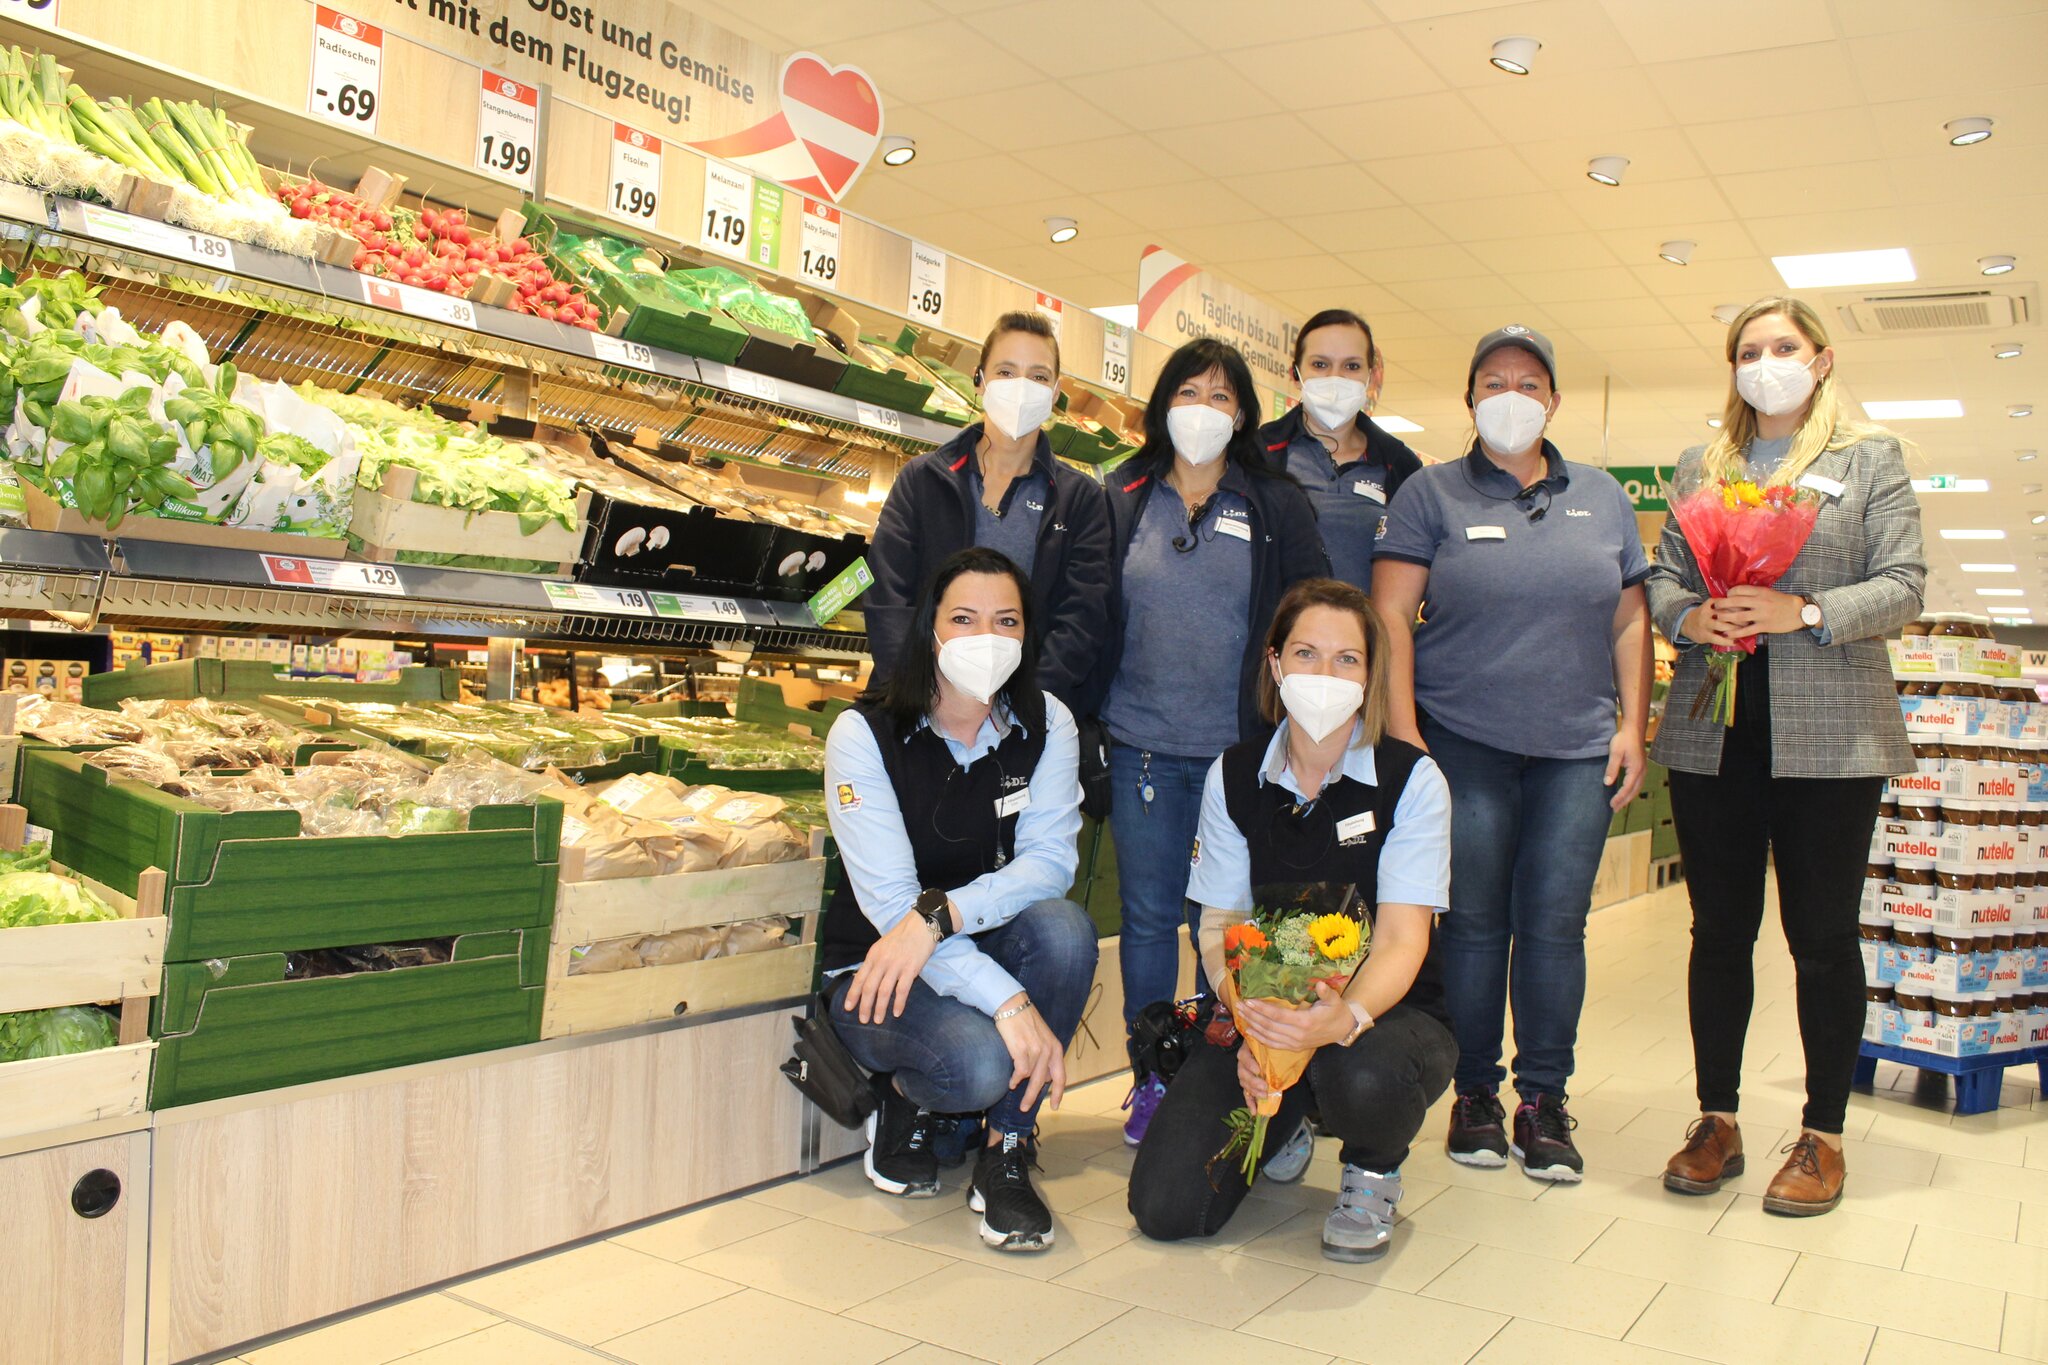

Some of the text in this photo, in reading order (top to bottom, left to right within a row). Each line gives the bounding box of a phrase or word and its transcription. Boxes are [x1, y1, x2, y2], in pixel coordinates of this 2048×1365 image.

[319, 37, 377, 67] Radieschen
[428, 0, 691, 124] mit dem Flugzeug!
[601, 21, 652, 60] und
[660, 41, 755, 105] Gemüse
[316, 84, 376, 121] -.69
[482, 101, 534, 125] Stangenbohnen
[482, 136, 531, 175] 1.99
[623, 152, 649, 169] Fisolen
[710, 171, 745, 191] Melanzani
[614, 182, 656, 218] 1.99
[707, 209, 745, 246] 1.19
[804, 221, 838, 240] Baby Spinat
[187, 234, 227, 258] 1.89
[803, 250, 836, 280] 1.49
[915, 252, 941, 268] Feldgurke
[912, 290, 942, 315] -.69
[442, 305, 471, 322] -.89
[1201, 293, 1245, 332] Täglich
[1247, 315, 1264, 342] bis
[1266, 330, 1279, 350] zu
[622, 342, 651, 364] 1.59
[1105, 361, 1126, 384] 1.99
[752, 377, 776, 397] 1.59
[877, 409, 898, 427] 1.99
[191, 464, 214, 483] IMAT
[164, 498, 202, 517] asilikum
[361, 568, 397, 586] 1.29
[616, 592, 643, 608] 1.19
[712, 600, 738, 616] 1.49
[1905, 652, 1933, 661] nutella
[1981, 648, 2006, 661] nutella
[1916, 713, 1955, 725] nutella
[1891, 775, 1941, 791] nutella
[1978, 777, 2015, 796] nutella
[1887, 841, 1938, 857] nutella
[1977, 841, 2015, 860] nutella
[1883, 901, 1932, 919] nutella
[1971, 904, 2011, 923] nutella
[1907, 970, 1935, 981] nutella
[1994, 969, 2017, 981] nutella
[1906, 1034, 1933, 1046] nutella
[1995, 1031, 2018, 1045] nutella
